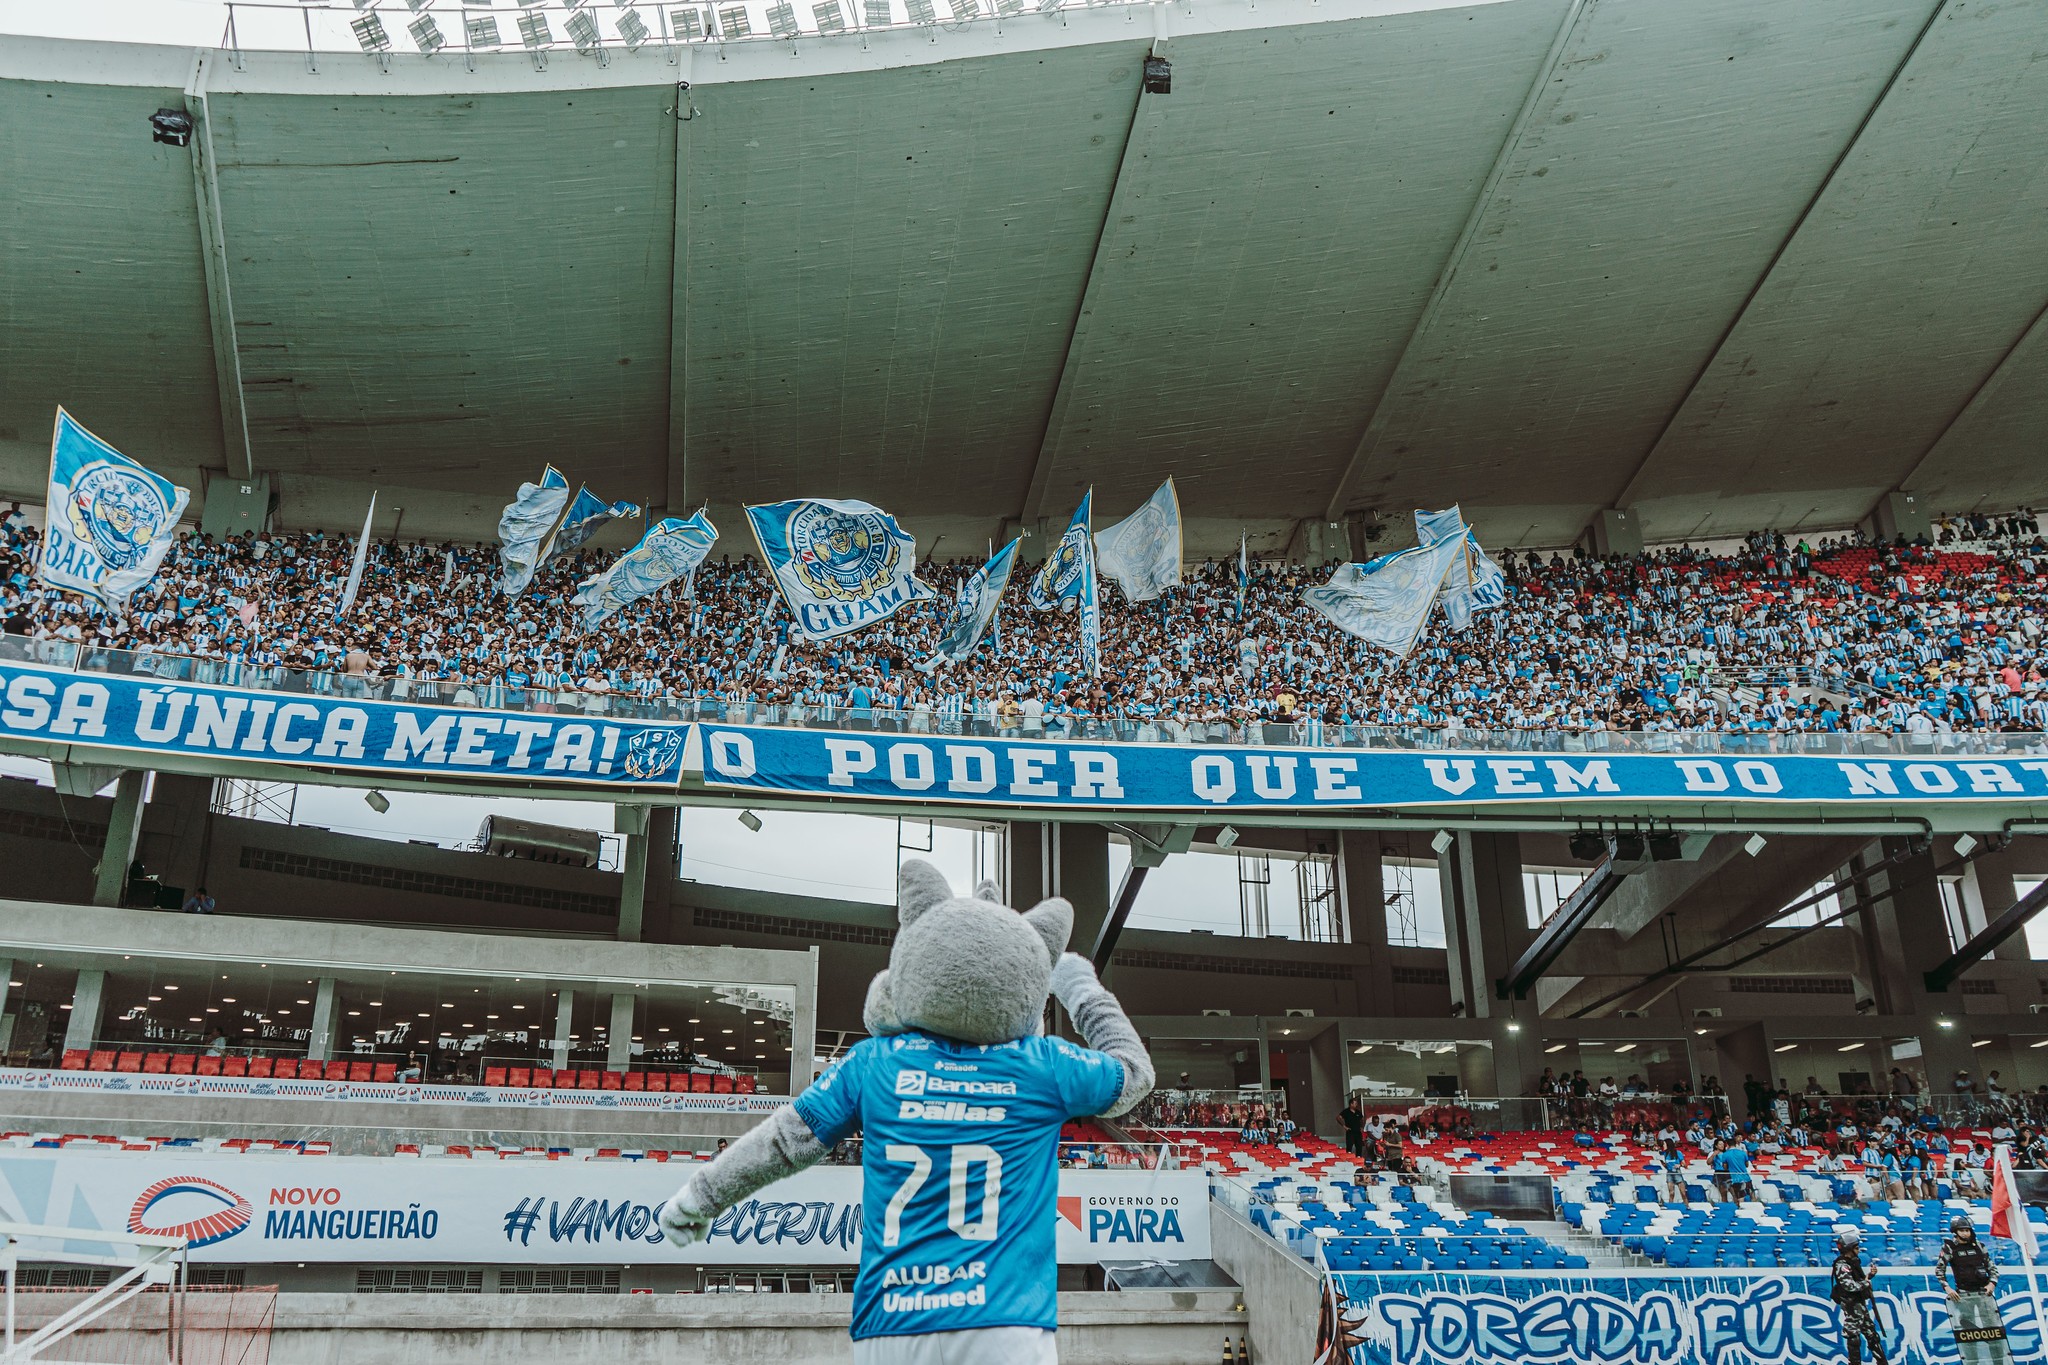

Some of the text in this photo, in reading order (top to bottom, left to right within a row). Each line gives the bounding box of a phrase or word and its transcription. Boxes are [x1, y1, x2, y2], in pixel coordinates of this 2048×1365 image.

[0, 674, 621, 775] SA ÚNICA META!
[709, 731, 757, 778] O
[824, 738, 1124, 799] PODER
[1191, 754, 1362, 803] QUE
[1422, 758, 1621, 797] VEM
[1674, 759, 1784, 793] DO
[928, 1076, 1016, 1095] Banpará
[899, 1100, 1007, 1121] Dallas
[269, 1187, 340, 1206] NOVO
[884, 1144, 1003, 1247] 70
[1089, 1196, 1179, 1206] GOVERNO DO
[264, 1203, 438, 1239] MANGUEIRÃO
[882, 1261, 987, 1288] ALUBAR
[883, 1284, 986, 1313] Unimed
[1380, 1296, 1681, 1363] TORCIDA
[1960, 1329, 2001, 1341] CHOQUE
